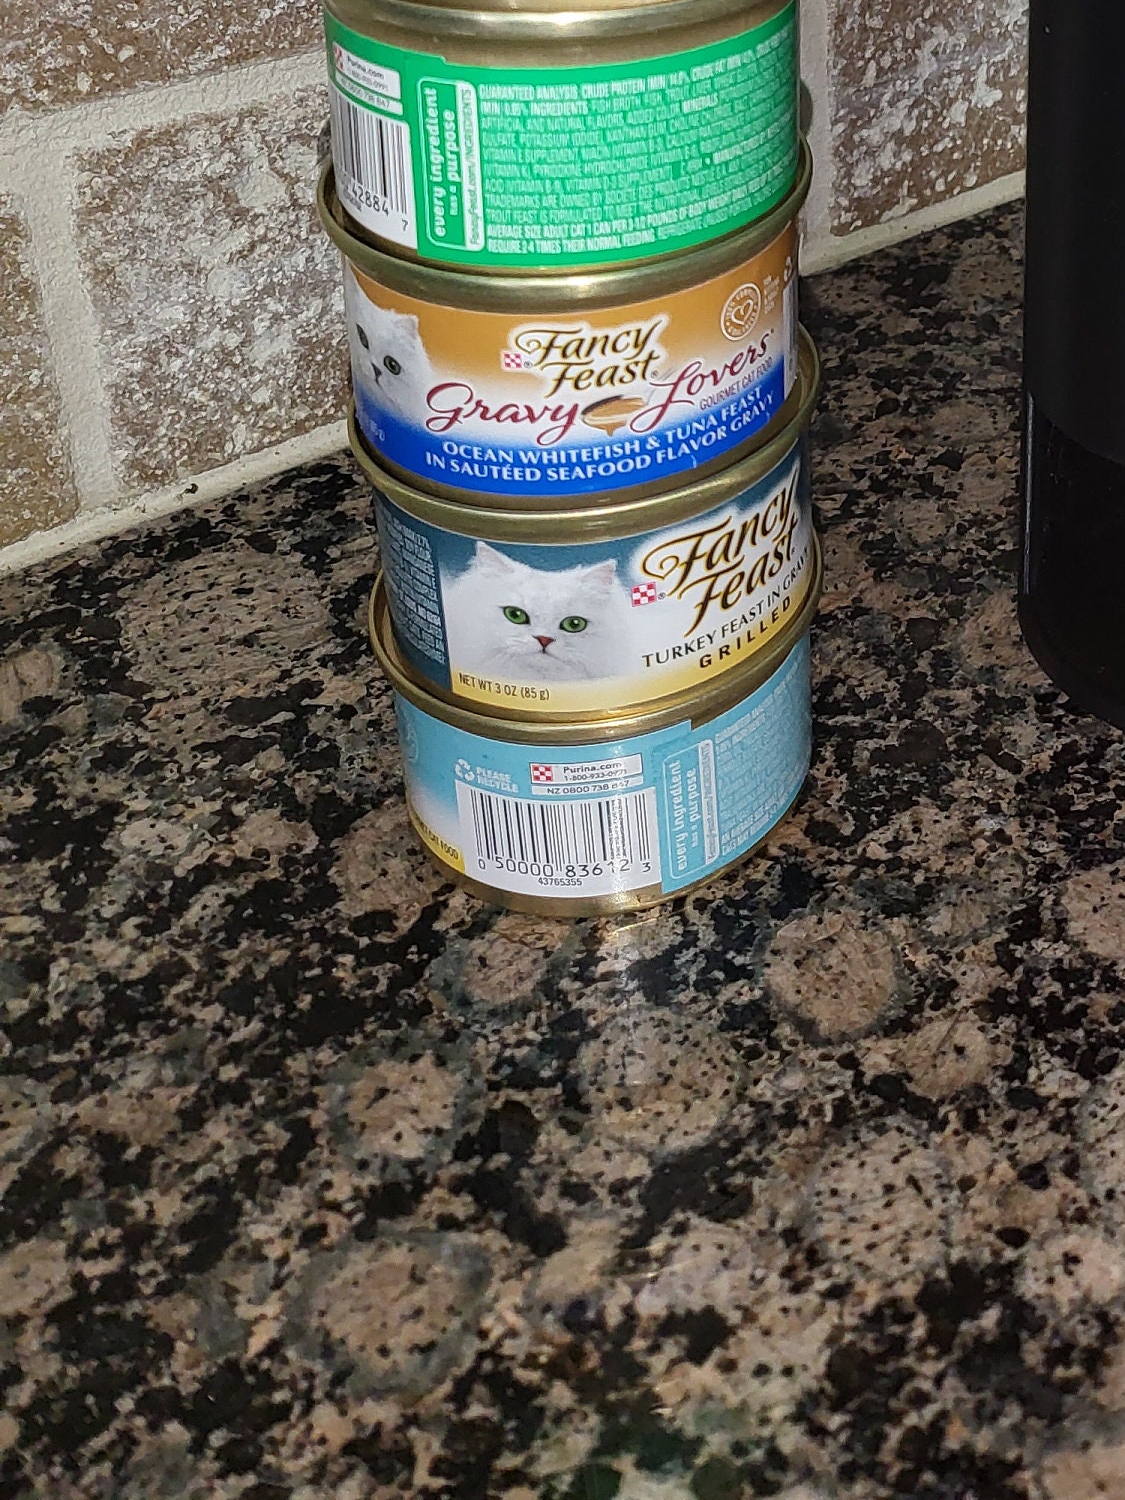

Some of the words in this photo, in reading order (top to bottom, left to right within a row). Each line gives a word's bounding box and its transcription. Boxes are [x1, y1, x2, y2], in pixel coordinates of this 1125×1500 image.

[424, 87, 444, 182] ingredient
[443, 109, 461, 182] purpose
[402, 219, 409, 231] 7
[434, 186, 446, 238] every
[515, 319, 664, 367] Fancy
[540, 350, 660, 399] Feast
[700, 384, 740, 411] GOURMET
[742, 374, 755, 389] CAT
[756, 356, 774, 379] FOOD
[425, 382, 579, 446] Gravy
[425, 452, 446, 470] IN
[450, 459, 541, 482] SAUTÉED
[547, 452, 651, 481] SEAFOOD
[656, 428, 728, 465] FLAVOR
[731, 392, 774, 431] GRAVY
[443, 441, 514, 464] OCEAN
[518, 440, 641, 465] WHITEFISH
[646, 435, 661, 450] &
[664, 414, 718, 444] TUNA
[721, 386, 761, 422] FEAST
[641, 468, 798, 597] Fancy
[677, 511, 799, 638] Feast
[642, 629, 717, 668] TURKEY
[721, 599, 765, 638] FEAST
[767, 586, 781, 608] IN
[699, 595, 792, 669] GRILLED
[459, 672, 476, 688] NET
[477, 679, 493, 692] WT
[494, 681, 502, 693] 3
[504, 684, 518, 697] OZ
[520, 683, 538, 699] (85
[539, 687, 550, 701] g)
[477, 766, 512, 784] PLEASE
[477, 775, 519, 793] RECYCLE
[547, 787, 560, 795] NZ
[562, 786, 590, 795] 0800
[592, 783, 609, 792] 738
[563, 762, 622, 774] Purina.com
[669, 760, 687, 831] ingredient
[687, 767, 701, 823] purpose
[478, 858, 487, 870] 0
[495, 856, 555, 877] 50000
[642, 861, 651, 874] 3
[675, 832, 688, 871] every
[538, 876, 583, 887] 43765355
